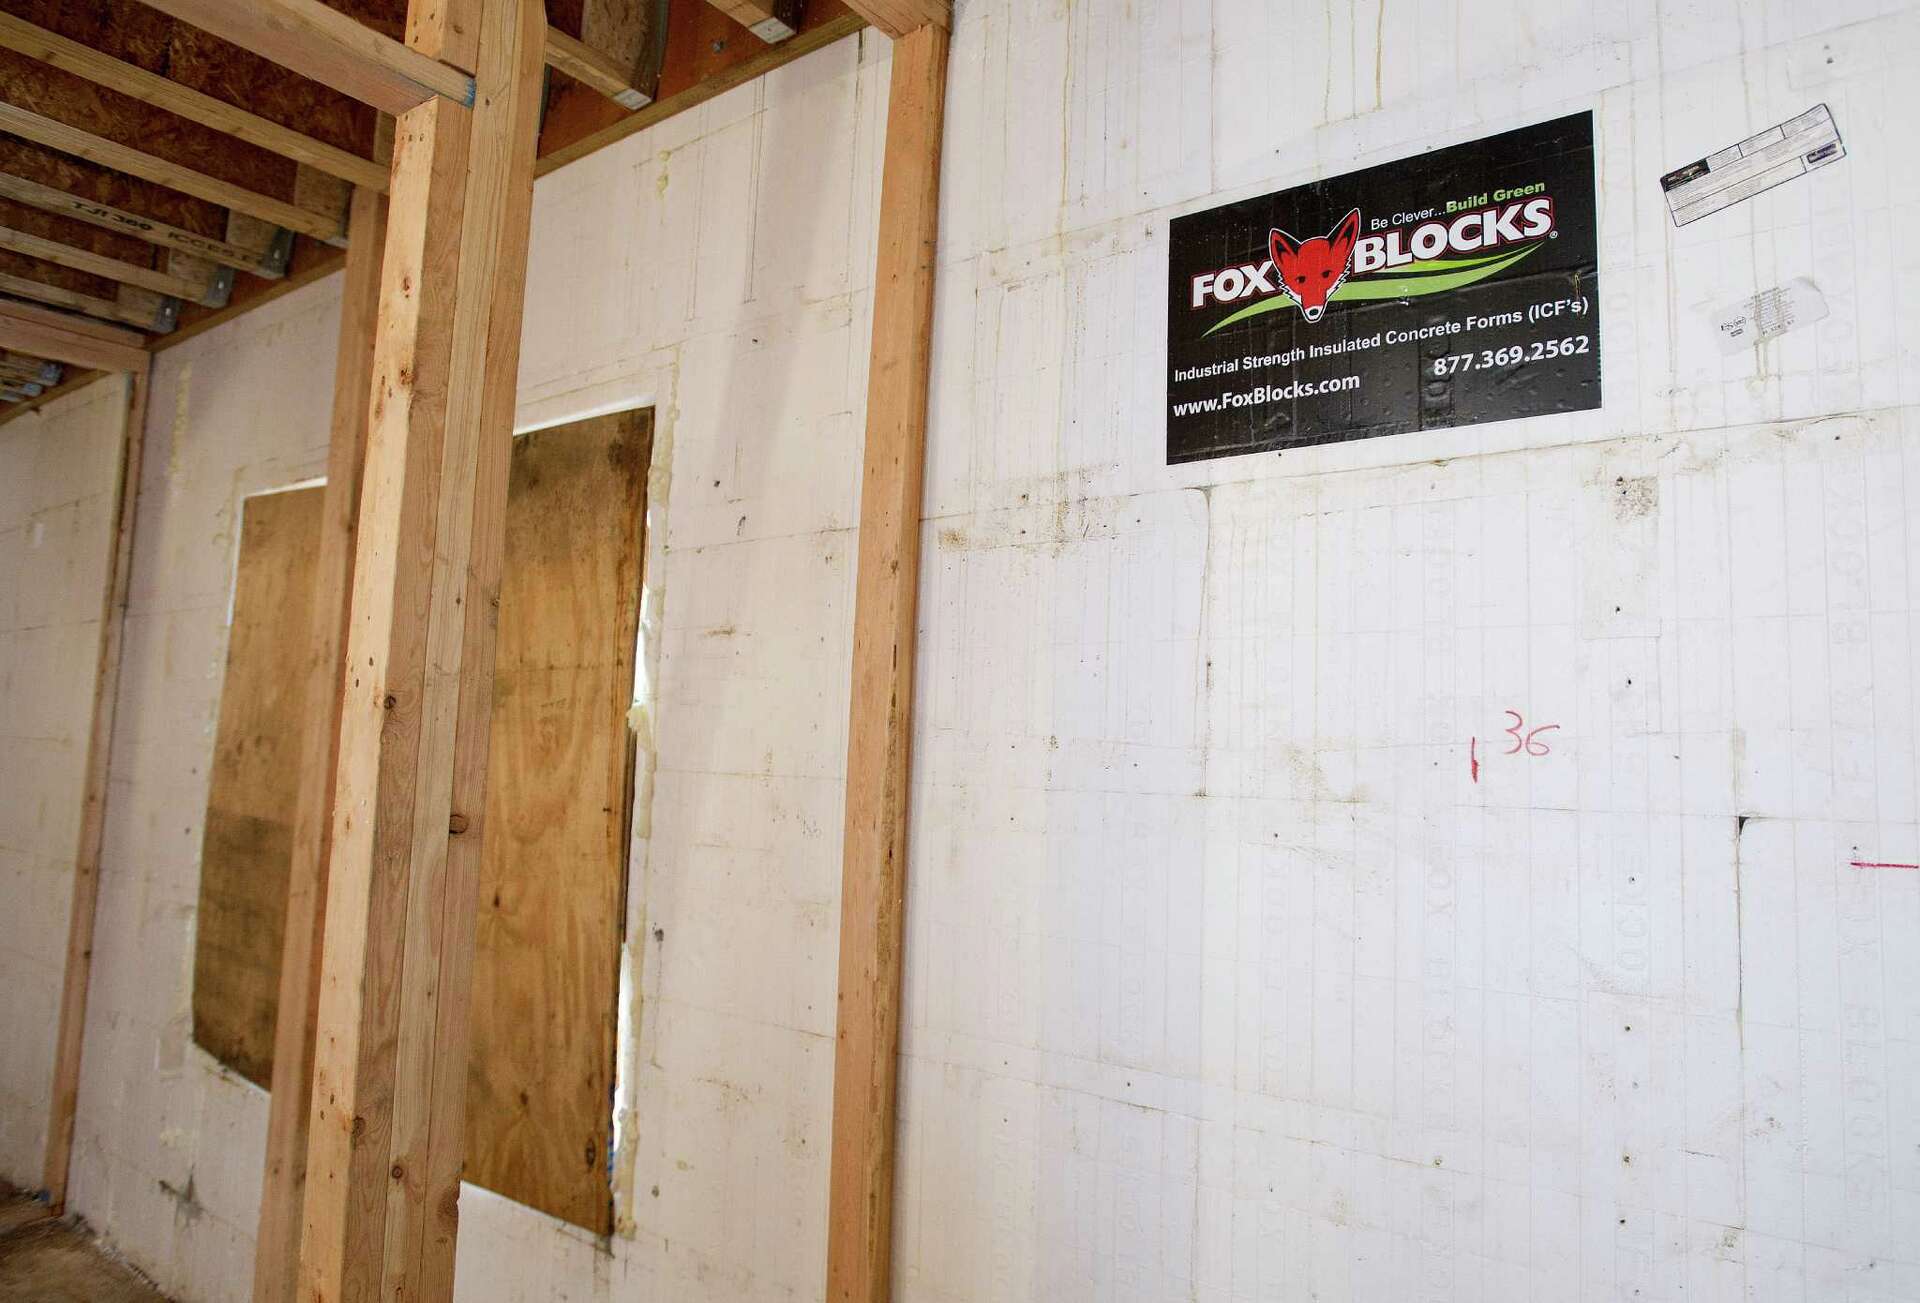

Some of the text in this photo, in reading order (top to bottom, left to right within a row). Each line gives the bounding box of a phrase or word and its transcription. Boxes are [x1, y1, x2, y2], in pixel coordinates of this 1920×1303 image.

[1370, 217, 1389, 231] Be
[1445, 192, 1488, 214] Build
[1493, 182, 1546, 202] Green
[1192, 199, 1552, 308] FOX BLOCKS
[1174, 296, 1589, 383] Industrial Strength Insulated Concrete Forms (ICF's)
[1432, 335, 1590, 377] 877.369.2562
[1172, 375, 1361, 418] www.FoxBlocks.com
